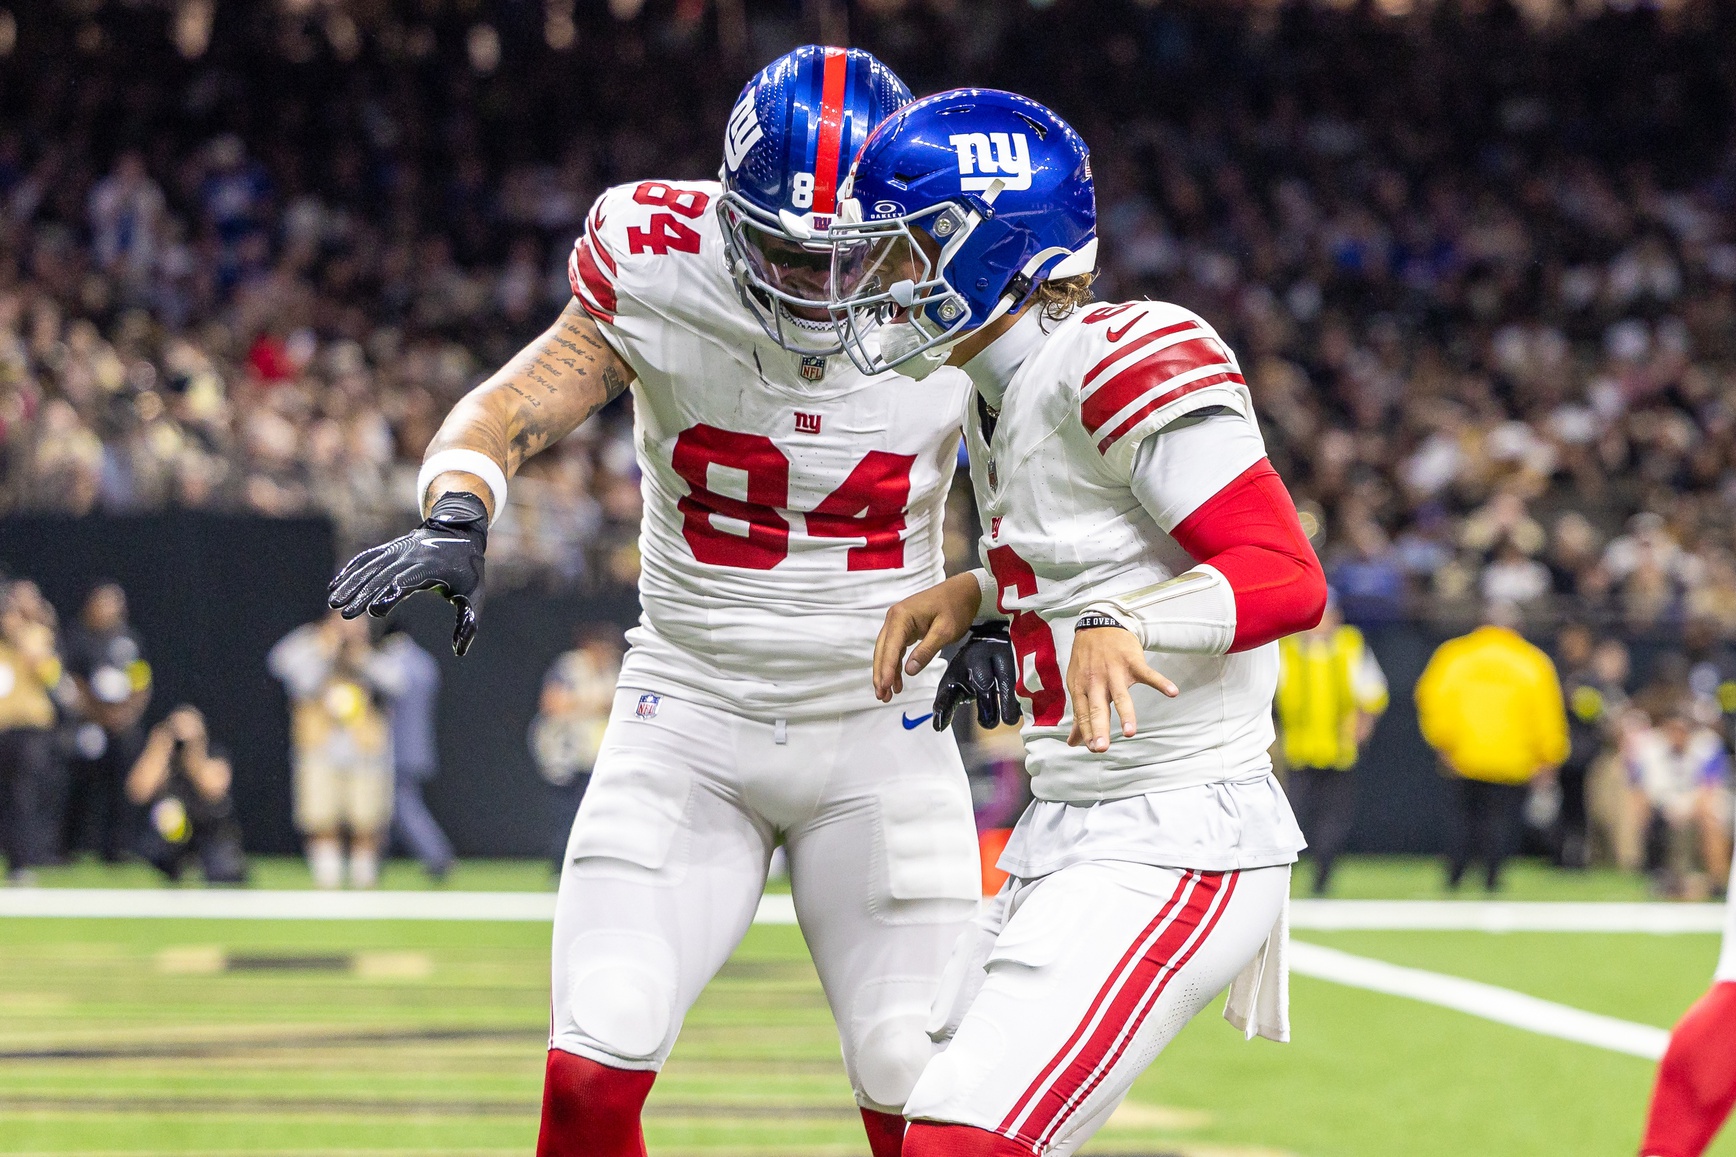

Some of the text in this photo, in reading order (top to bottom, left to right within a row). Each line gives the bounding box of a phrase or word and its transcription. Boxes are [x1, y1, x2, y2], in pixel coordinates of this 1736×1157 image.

[949, 132, 1032, 191] ny
[626, 181, 710, 255] 84
[870, 211, 903, 219] OAKLEY
[803, 366, 821, 379] NFL
[794, 411, 822, 435] ny
[671, 423, 918, 571] 84
[987, 544, 1065, 727] 6
[1093, 617, 1116, 626] OVER
